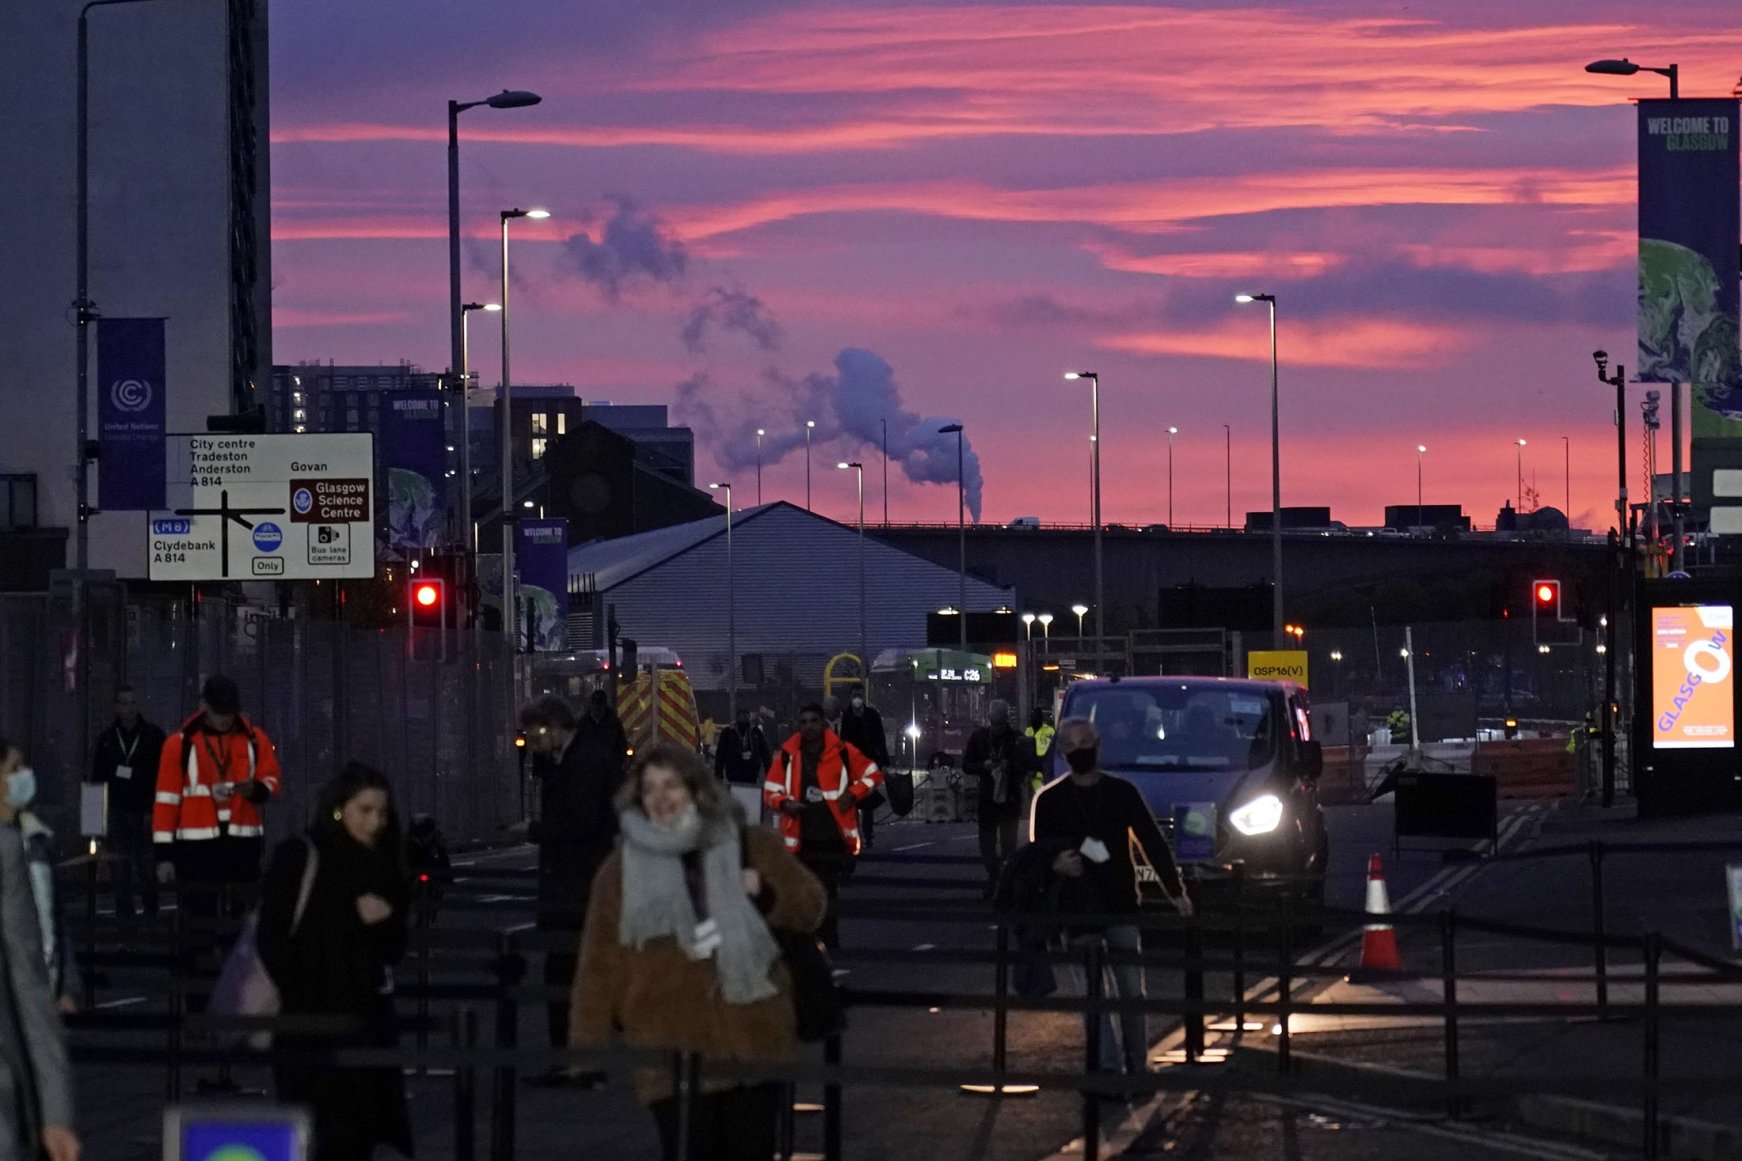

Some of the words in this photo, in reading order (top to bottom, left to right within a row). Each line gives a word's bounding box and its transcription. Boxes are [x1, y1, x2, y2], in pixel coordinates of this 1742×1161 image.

[1647, 117, 1710, 134] WELCOME
[1712, 116, 1729, 134] TO
[190, 439, 214, 450] City
[217, 439, 256, 449] centre
[190, 452, 248, 461] Tradeston
[190, 464, 251, 474] Anderston
[290, 461, 328, 472] Govan
[315, 482, 366, 494] Glasgow
[318, 495, 364, 506] Science
[321, 507, 361, 518] Centre
[154, 540, 216, 552] Clydebank
[311, 546, 326, 554] Bus
[329, 546, 347, 554] lane
[311, 554, 346, 562] cameras
[257, 562, 279, 572] Only
[964, 669, 981, 681] C26
